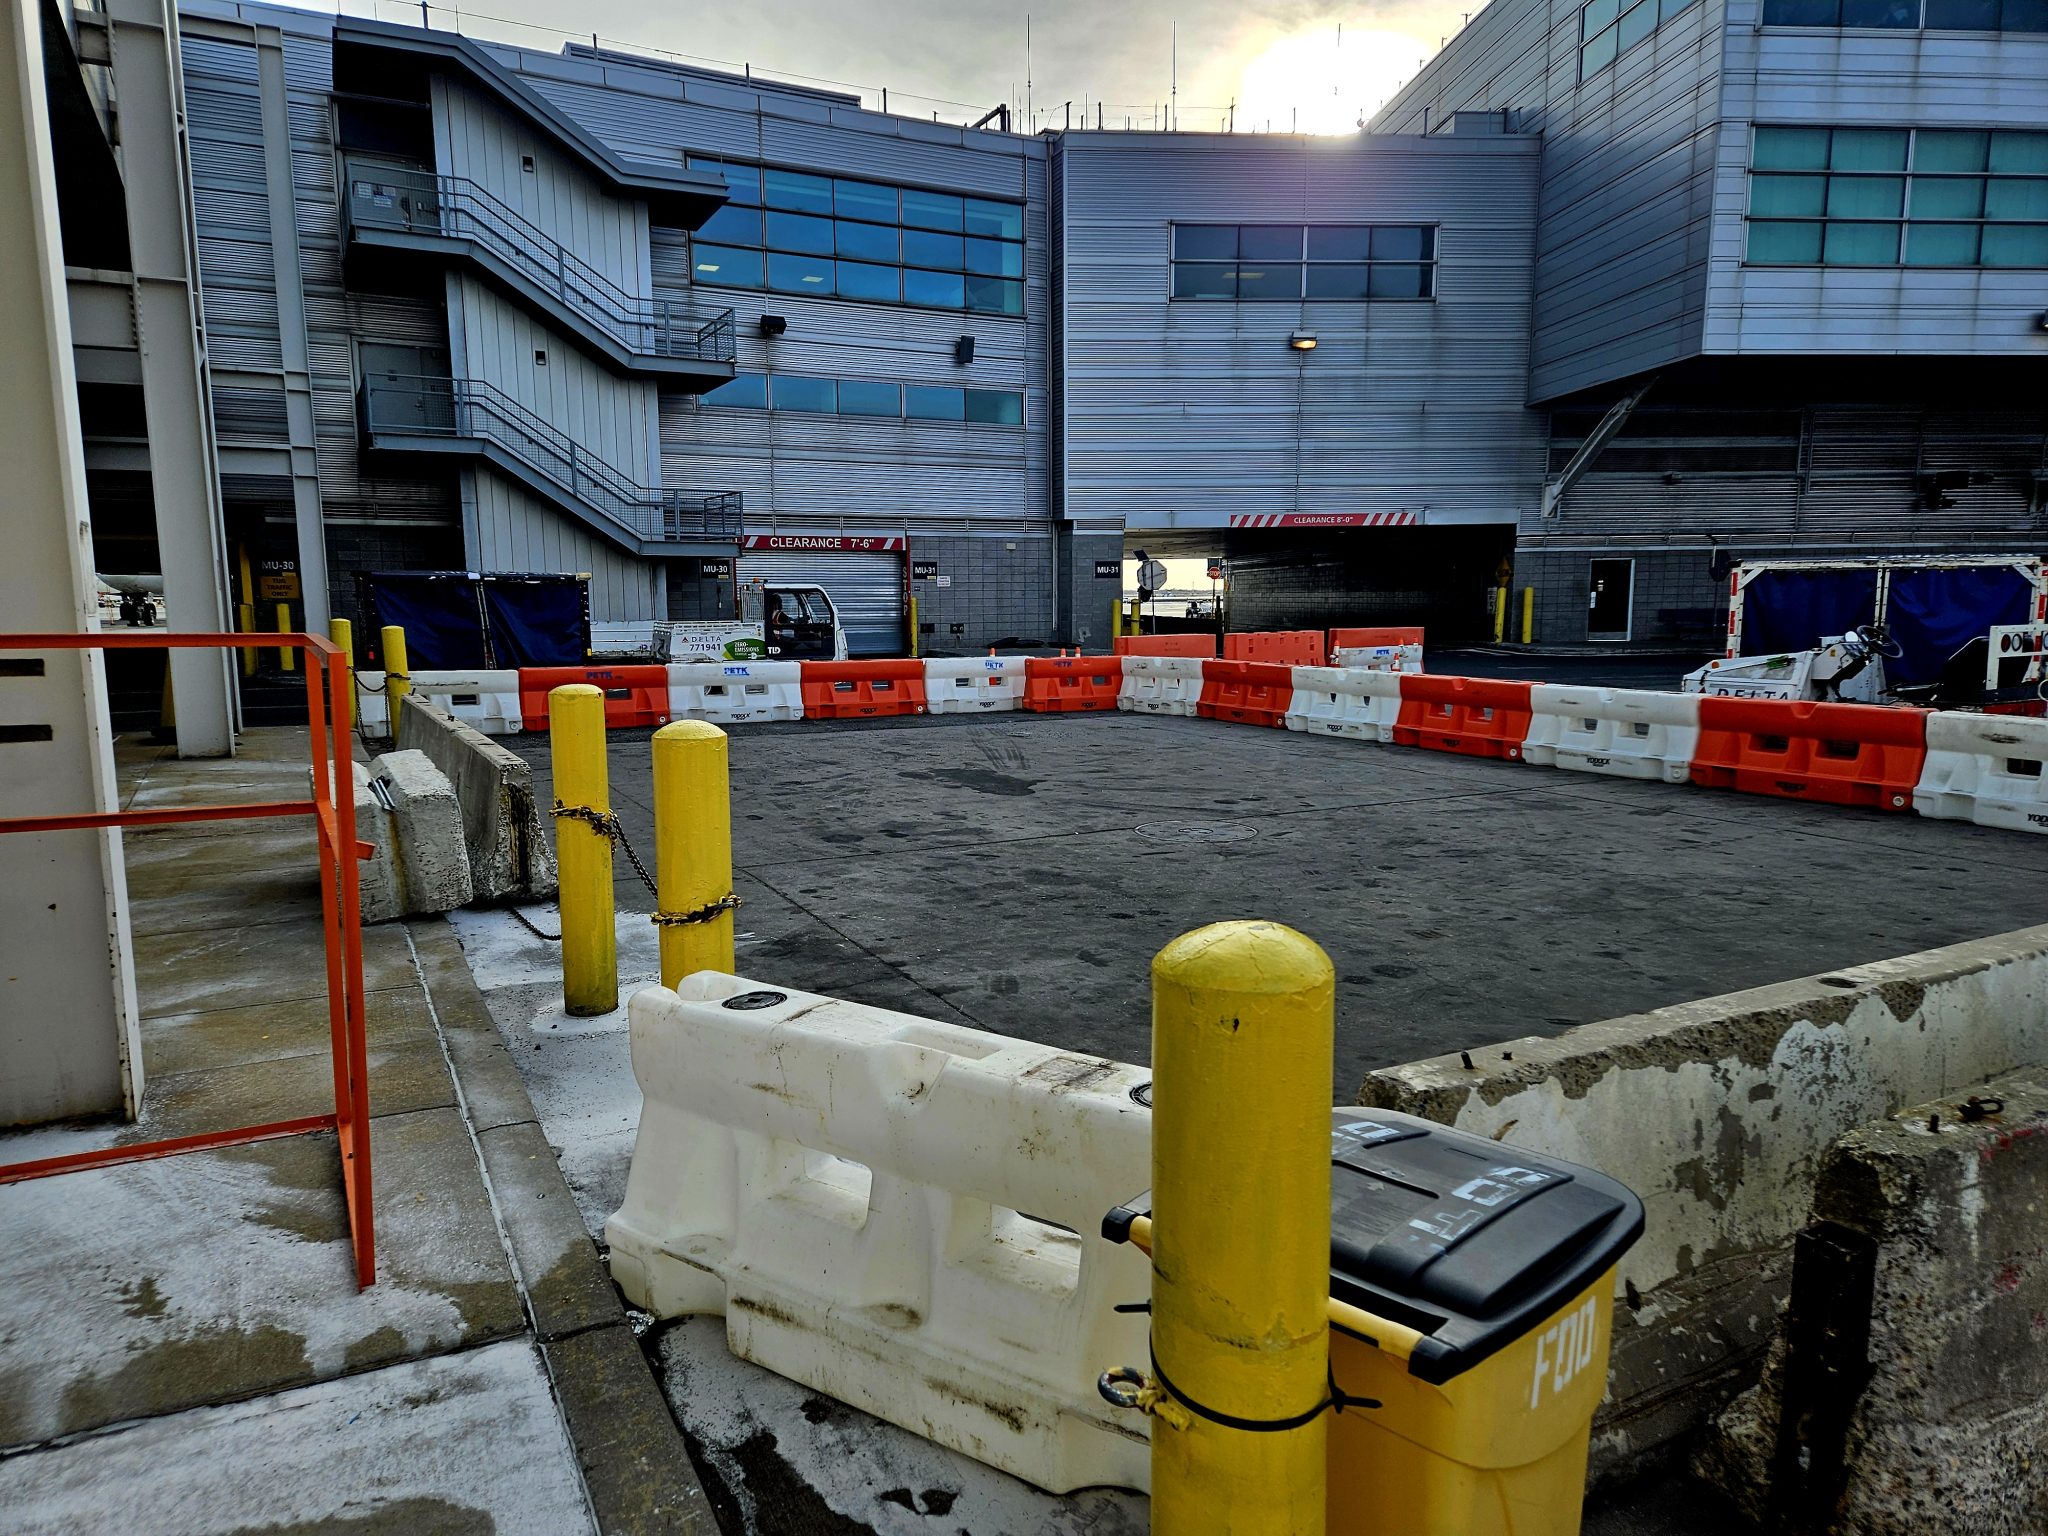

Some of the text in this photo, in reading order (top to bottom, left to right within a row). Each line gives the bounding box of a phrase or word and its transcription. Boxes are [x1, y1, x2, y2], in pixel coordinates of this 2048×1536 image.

[770, 537, 875, 549] CLEARANCE 7'-6"
[261, 561, 294, 570] MU-30
[703, 565, 728, 573] MU-30
[914, 566, 936, 574] MU-31
[1096, 566, 1119, 574] MU-31
[1208, 570, 1220, 578] STOP
[690, 643, 721, 651] 771941
